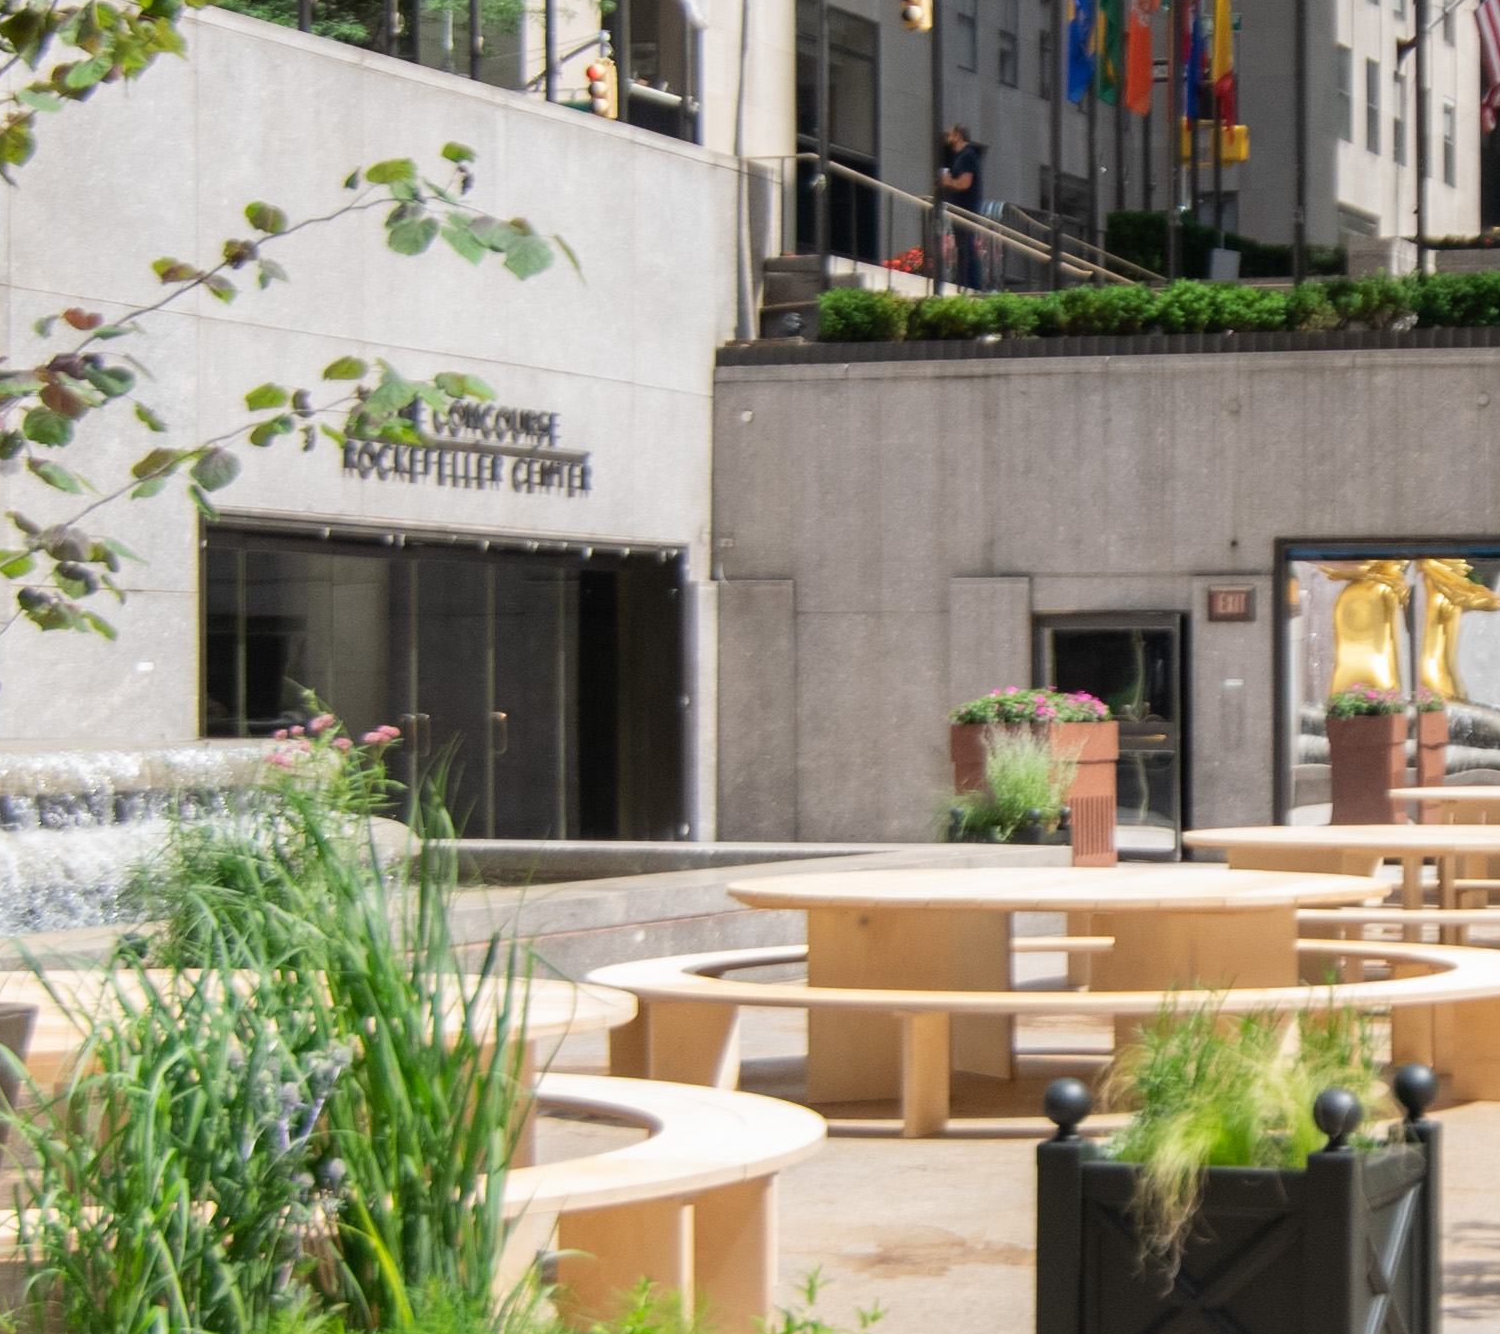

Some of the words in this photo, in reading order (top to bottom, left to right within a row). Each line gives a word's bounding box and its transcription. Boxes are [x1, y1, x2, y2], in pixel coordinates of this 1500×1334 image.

[343, 439, 503, 487] ROCKEFELLER
[512, 457, 593, 496] CENTER
[1215, 591, 1247, 615] EXIT
